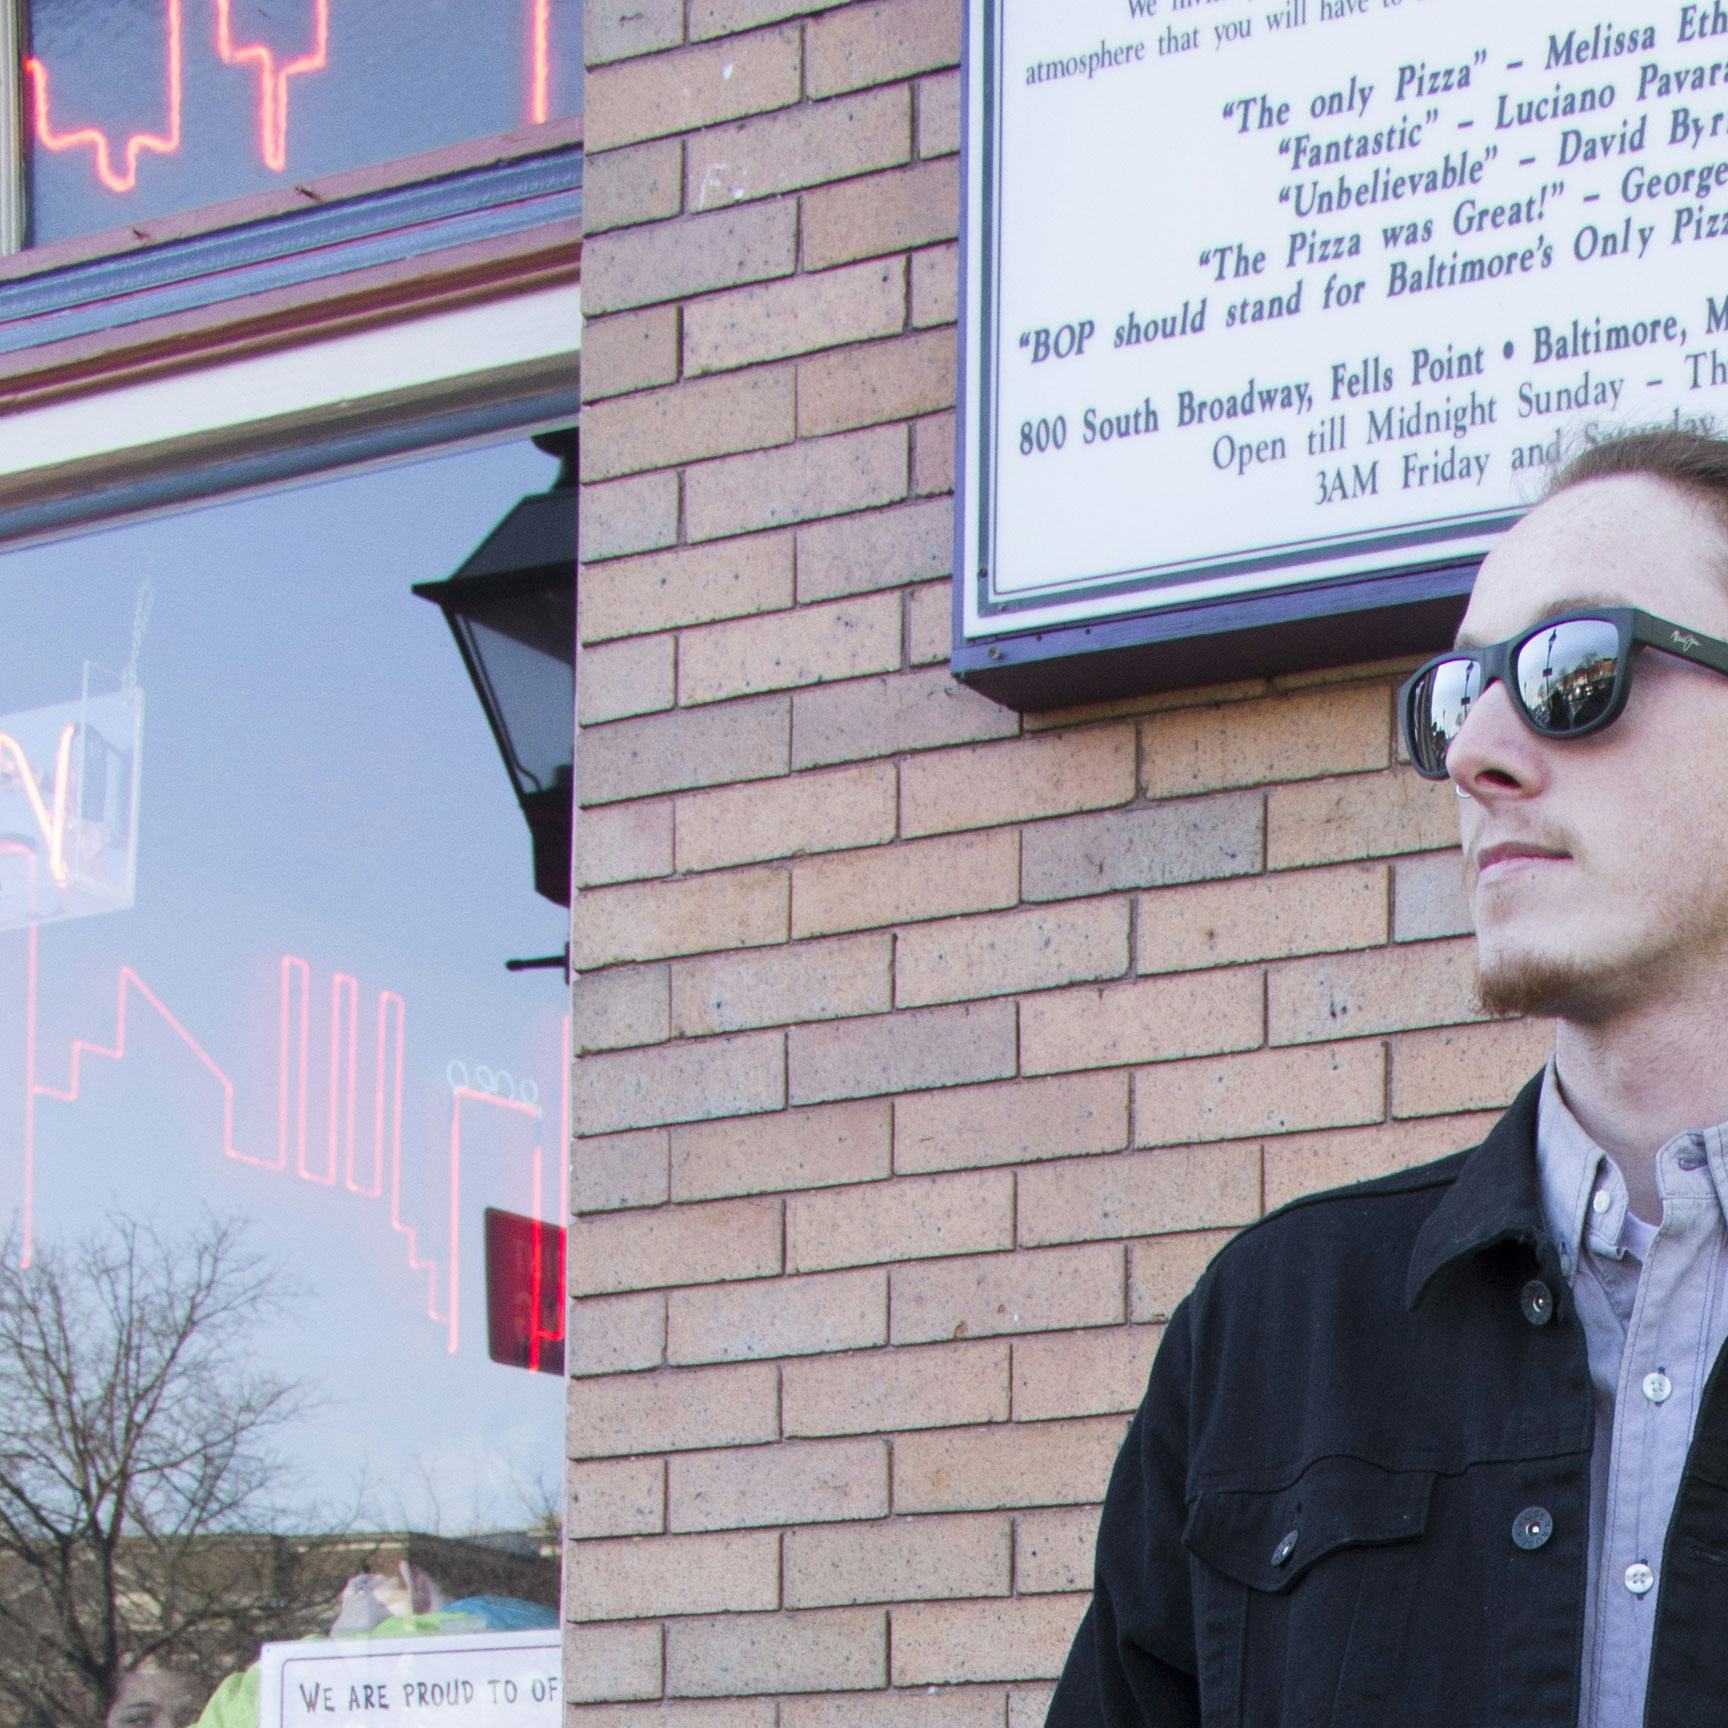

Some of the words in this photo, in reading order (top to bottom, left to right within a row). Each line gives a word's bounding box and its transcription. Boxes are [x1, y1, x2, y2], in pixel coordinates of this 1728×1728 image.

[1025, 39, 1145, 86] atmosphere
[1158, 25, 1200, 57] that
[1213, 18, 1252, 44] you
[1266, 0, 1306, 31] will
[1320, 0, 1369, 22] have
[1222, 93, 1291, 135] "The
[1309, 74, 1375, 119] only
[1394, 48, 1488, 102] Pizza"
[1544, 22, 1656, 71] Melissa
[1278, 107, 1439, 171] "Fantastic"
[1494, 82, 1616, 131] Luciano
[1278, 144, 1498, 218] "Unbelievable"
[1557, 113, 1648, 167] David
[1198, 242, 1267, 282] "The
[1285, 229, 1361, 269] Pizza
[1381, 219, 1434, 250] was
[1452, 180, 1565, 236] Great!"
[1018, 319, 1096, 365] "BOP
[1113, 297, 1208, 349] should
[1225, 278, 1304, 328] stand
[1322, 272, 1366, 310] for
[1386, 233, 1554, 298] Baltimore's
[1573, 216, 1655, 262] Only
[1019, 414, 1067, 457] 800
[1082, 396, 1160, 445] South
[1177, 377, 1313, 428] Broadway,
[1330, 355, 1394, 401] Fells
[1411, 343, 1485, 387] Point
[1532, 316, 1687, 365] Baltimore,
[1212, 434, 1287, 476] Open
[1307, 414, 1346, 456] till
[1366, 390, 1497, 445] Midnight
[1518, 370, 1625, 418] Sunday
[1315, 460, 1379, 506] 3AM
[1401, 445, 1490, 490] Friday
[1511, 428, 1561, 472] and
[300, 1682, 335, 1713] WE
[349, 1684, 389, 1711] ARE
[403, 1678, 474, 1707] PROUD
[487, 1679, 517, 1704] TO
